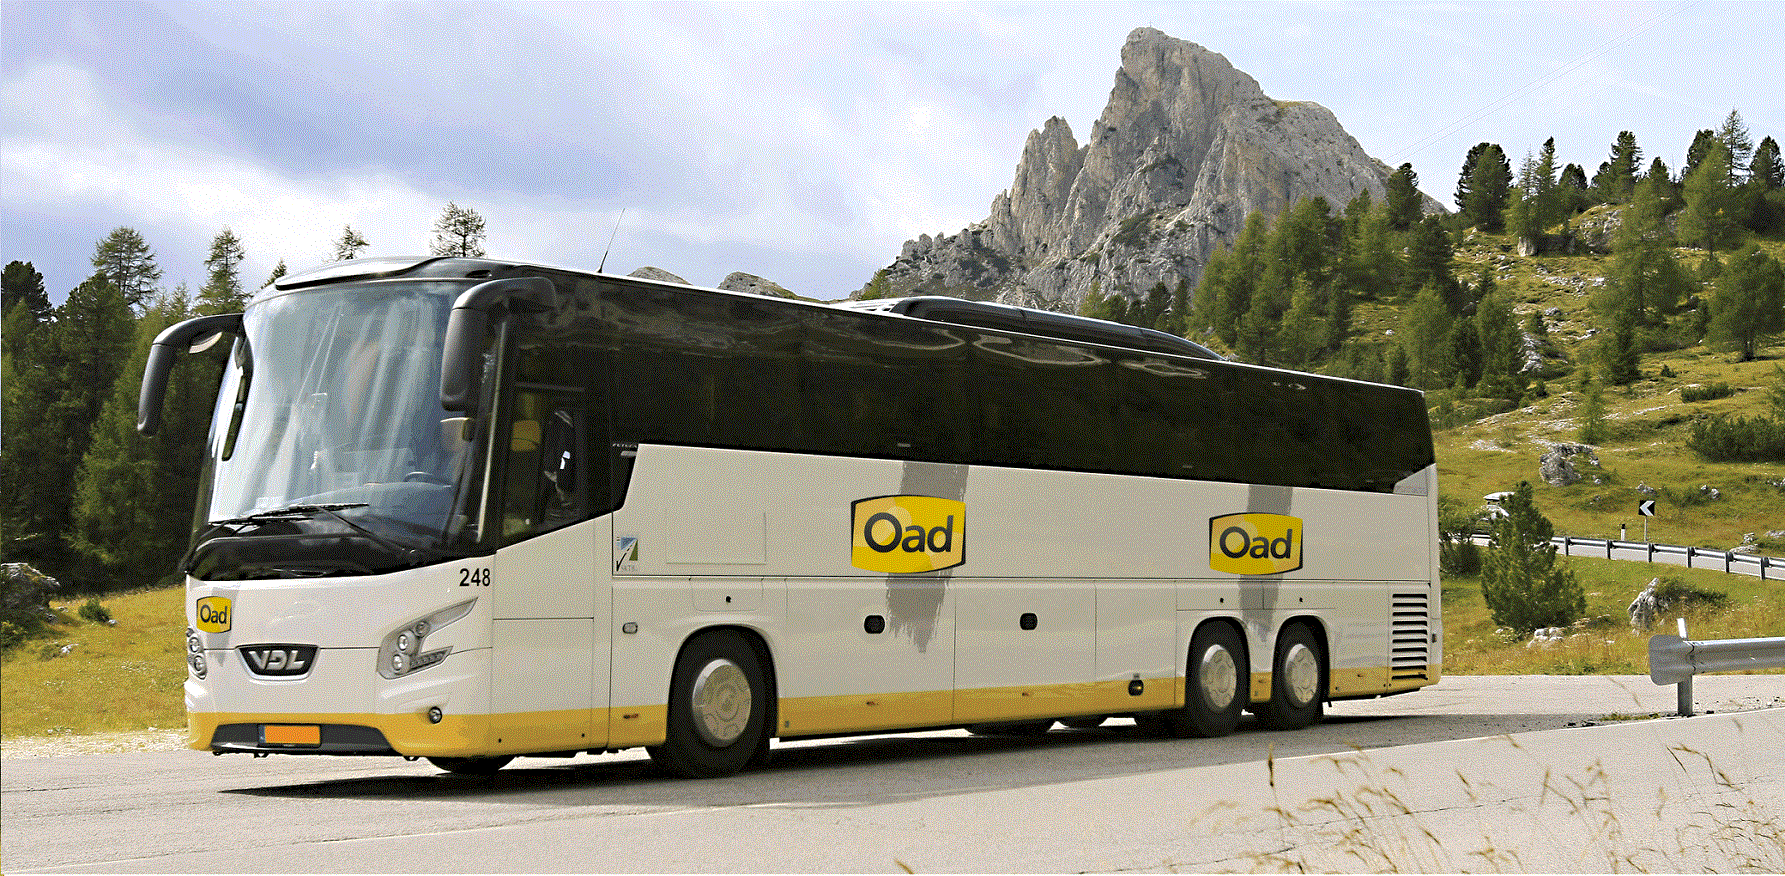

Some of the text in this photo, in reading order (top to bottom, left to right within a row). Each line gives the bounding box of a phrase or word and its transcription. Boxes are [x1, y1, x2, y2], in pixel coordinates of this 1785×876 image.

[864, 512, 954, 553] Oad
[1219, 526, 1293, 559] Oad
[459, 567, 491, 587] 248
[199, 604, 228, 625] Oad
[248, 649, 306, 670] VDL
